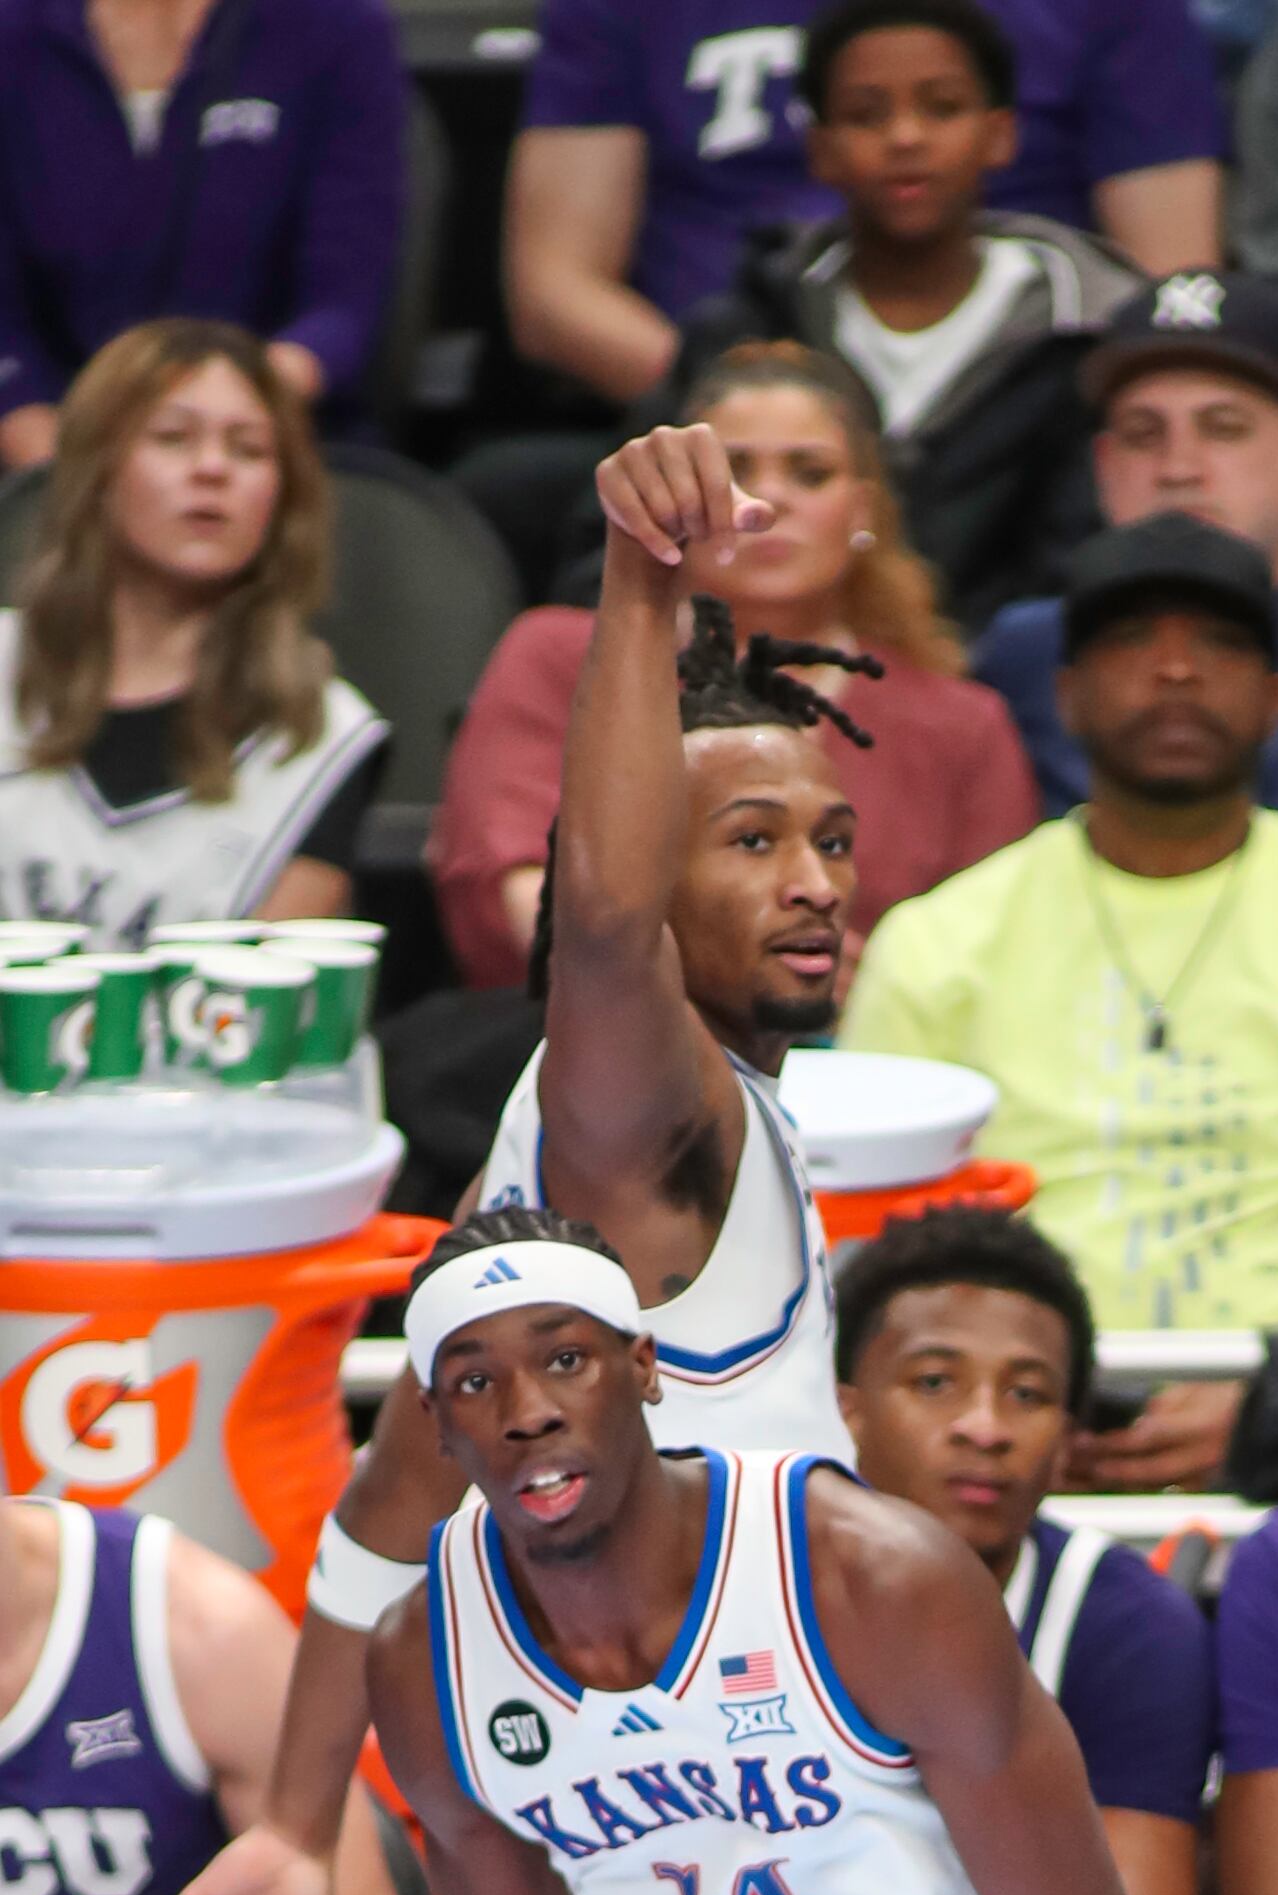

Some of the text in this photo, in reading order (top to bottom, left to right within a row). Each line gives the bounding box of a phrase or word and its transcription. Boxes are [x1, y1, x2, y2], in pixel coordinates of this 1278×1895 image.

[21, 1338, 157, 1484] G
[493, 1713, 545, 1756] SW
[514, 1752, 843, 1859] KANSAS
